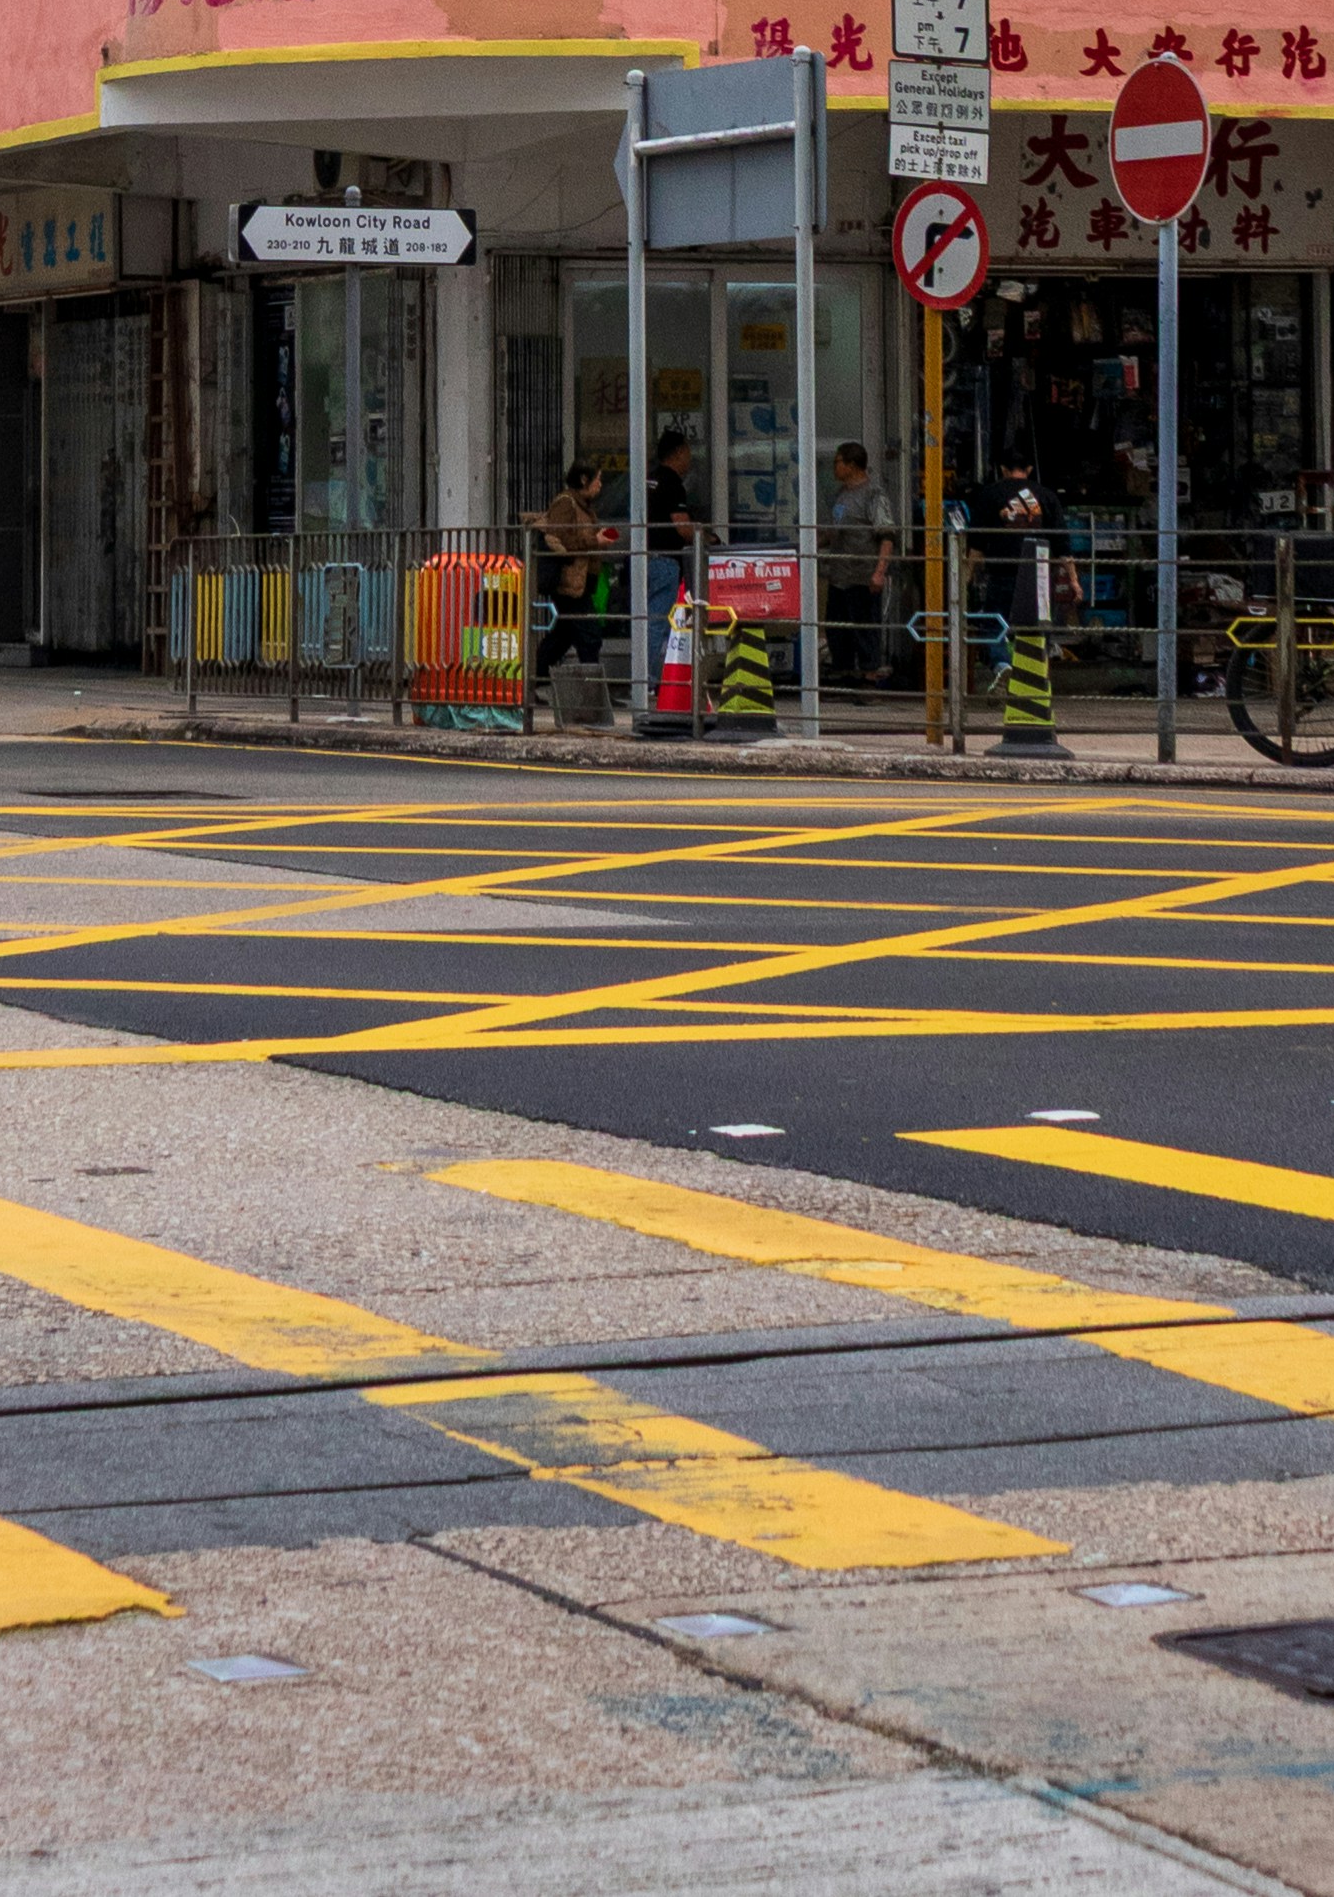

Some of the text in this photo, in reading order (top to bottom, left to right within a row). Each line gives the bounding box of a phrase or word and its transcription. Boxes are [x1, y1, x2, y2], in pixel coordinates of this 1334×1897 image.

[913, 35, 940, 52] 下午
[918, 22, 970, 54] pm 7
[921, 70, 959, 85] Except
[894, 81, 986, 102] General Holidays
[913, 130, 967, 147] Except taxi
[900, 143, 978, 161] pick up/drop off
[1020, 114, 1280, 200] 大行
[285, 213, 431, 231] Kowloon City Road
[317, 236, 401, 257] 九龍城道
